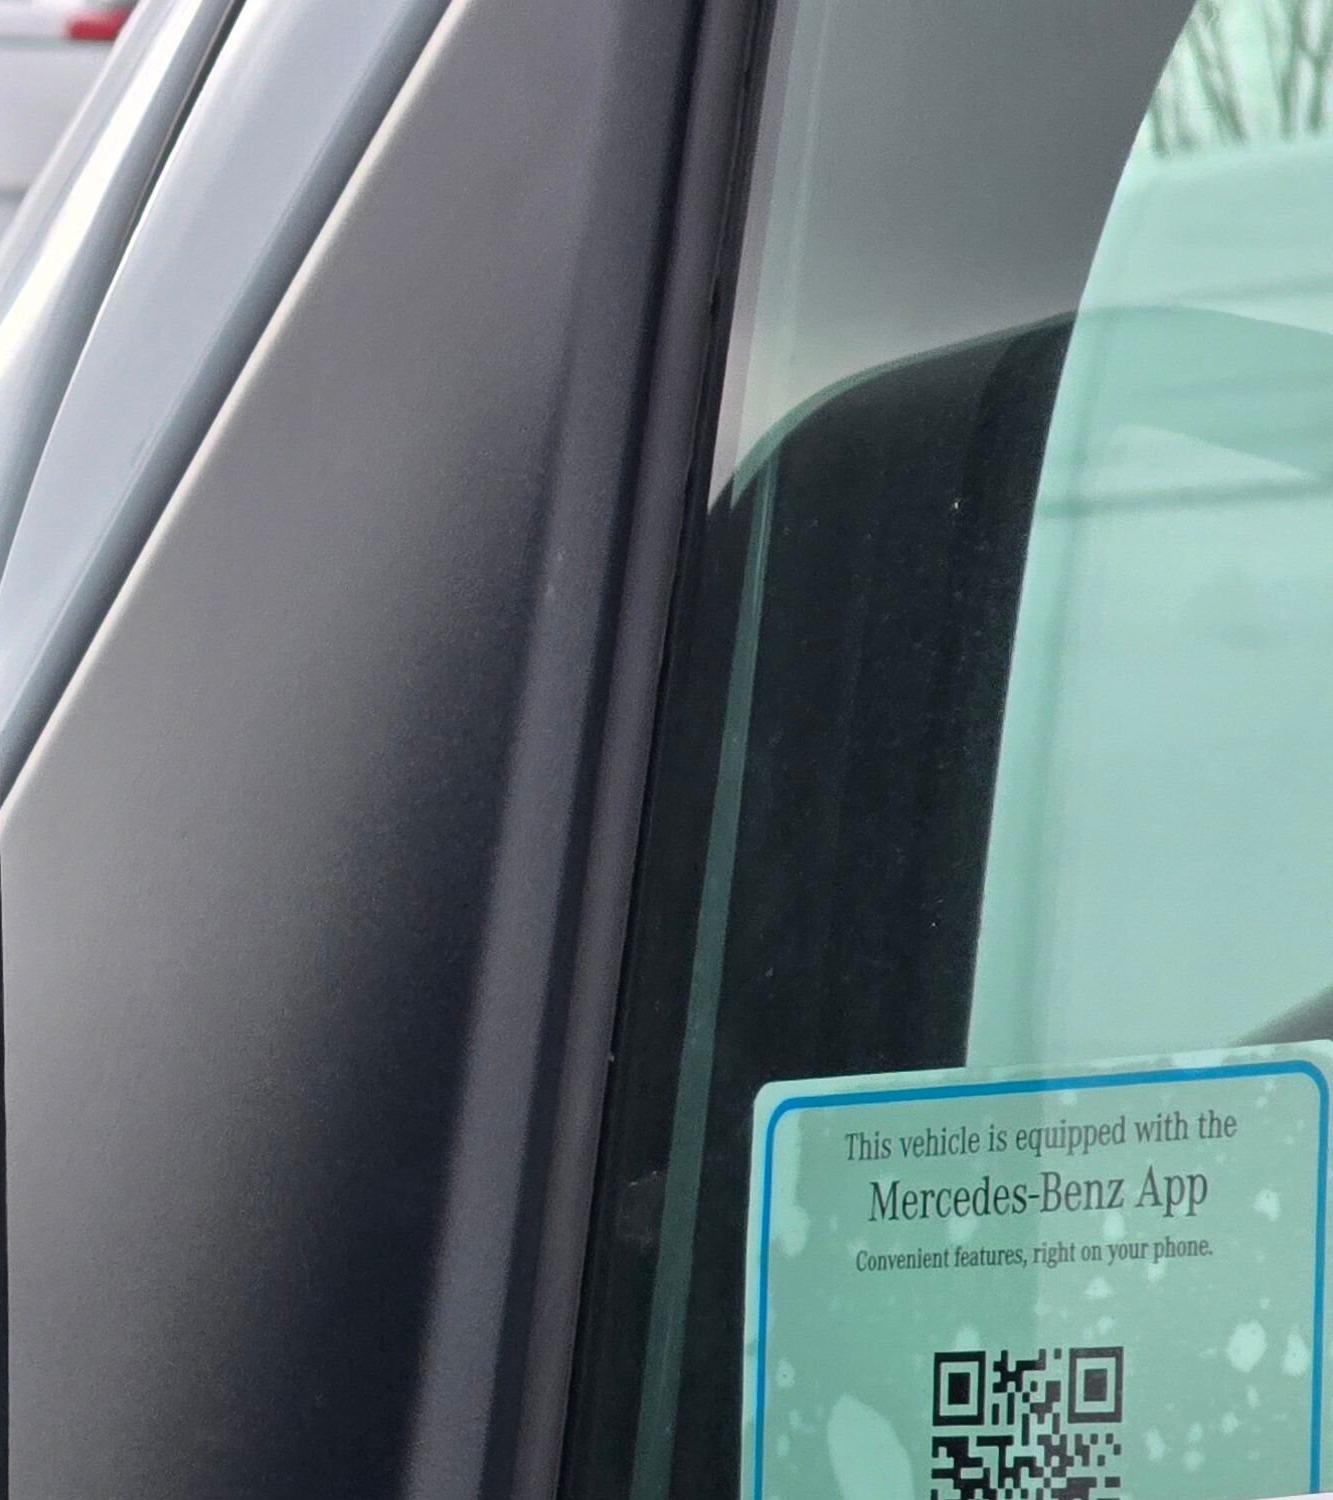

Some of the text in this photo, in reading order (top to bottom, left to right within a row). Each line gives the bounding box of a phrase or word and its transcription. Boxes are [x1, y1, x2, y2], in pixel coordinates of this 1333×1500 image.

[845, 1108, 1238, 1161] This vehicle is equipped with the
[868, 1164, 1209, 1221] Mercedes-Benz App
[855, 1236, 1213, 1272] Convenient features, right on your phone.
